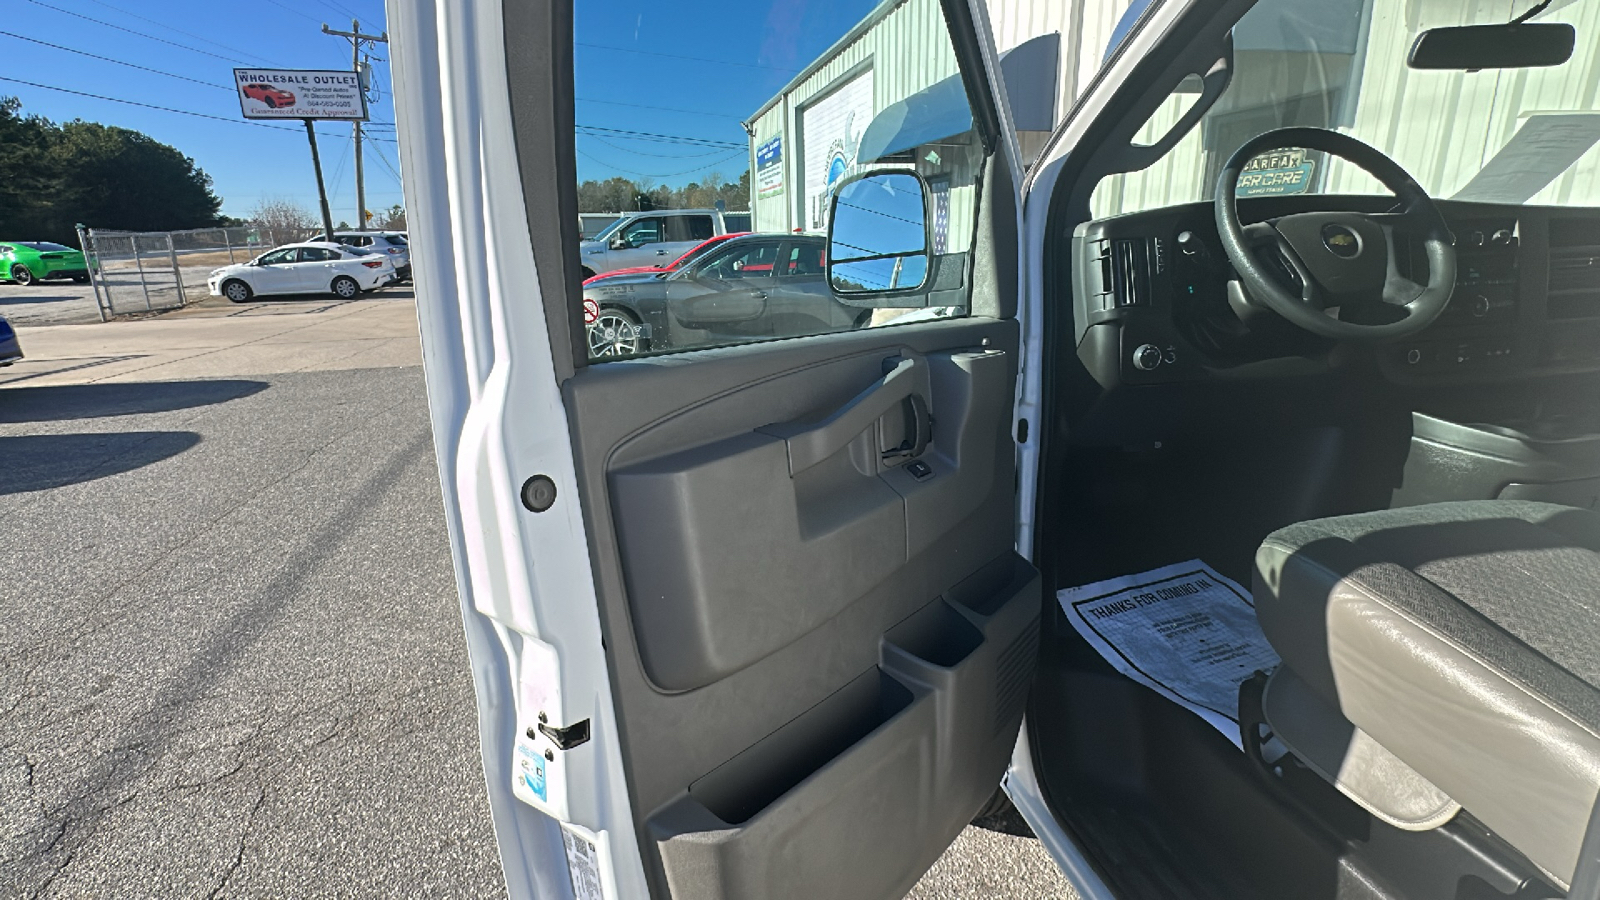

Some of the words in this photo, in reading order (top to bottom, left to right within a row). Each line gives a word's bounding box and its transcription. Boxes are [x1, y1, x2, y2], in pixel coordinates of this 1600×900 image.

[239, 74, 309, 84] WHOLESALE
[313, 76, 356, 84] OUTLET
[250, 107, 295, 115] Guaranteed
[296, 108, 320, 116] Credit
[1262, 170, 1304, 186] CARE
[1088, 599, 1138, 620] THANKS
[1133, 592, 1160, 607] FOR
[1156, 583, 1199, 601] COMING
[1195, 579, 1213, 589] IN
